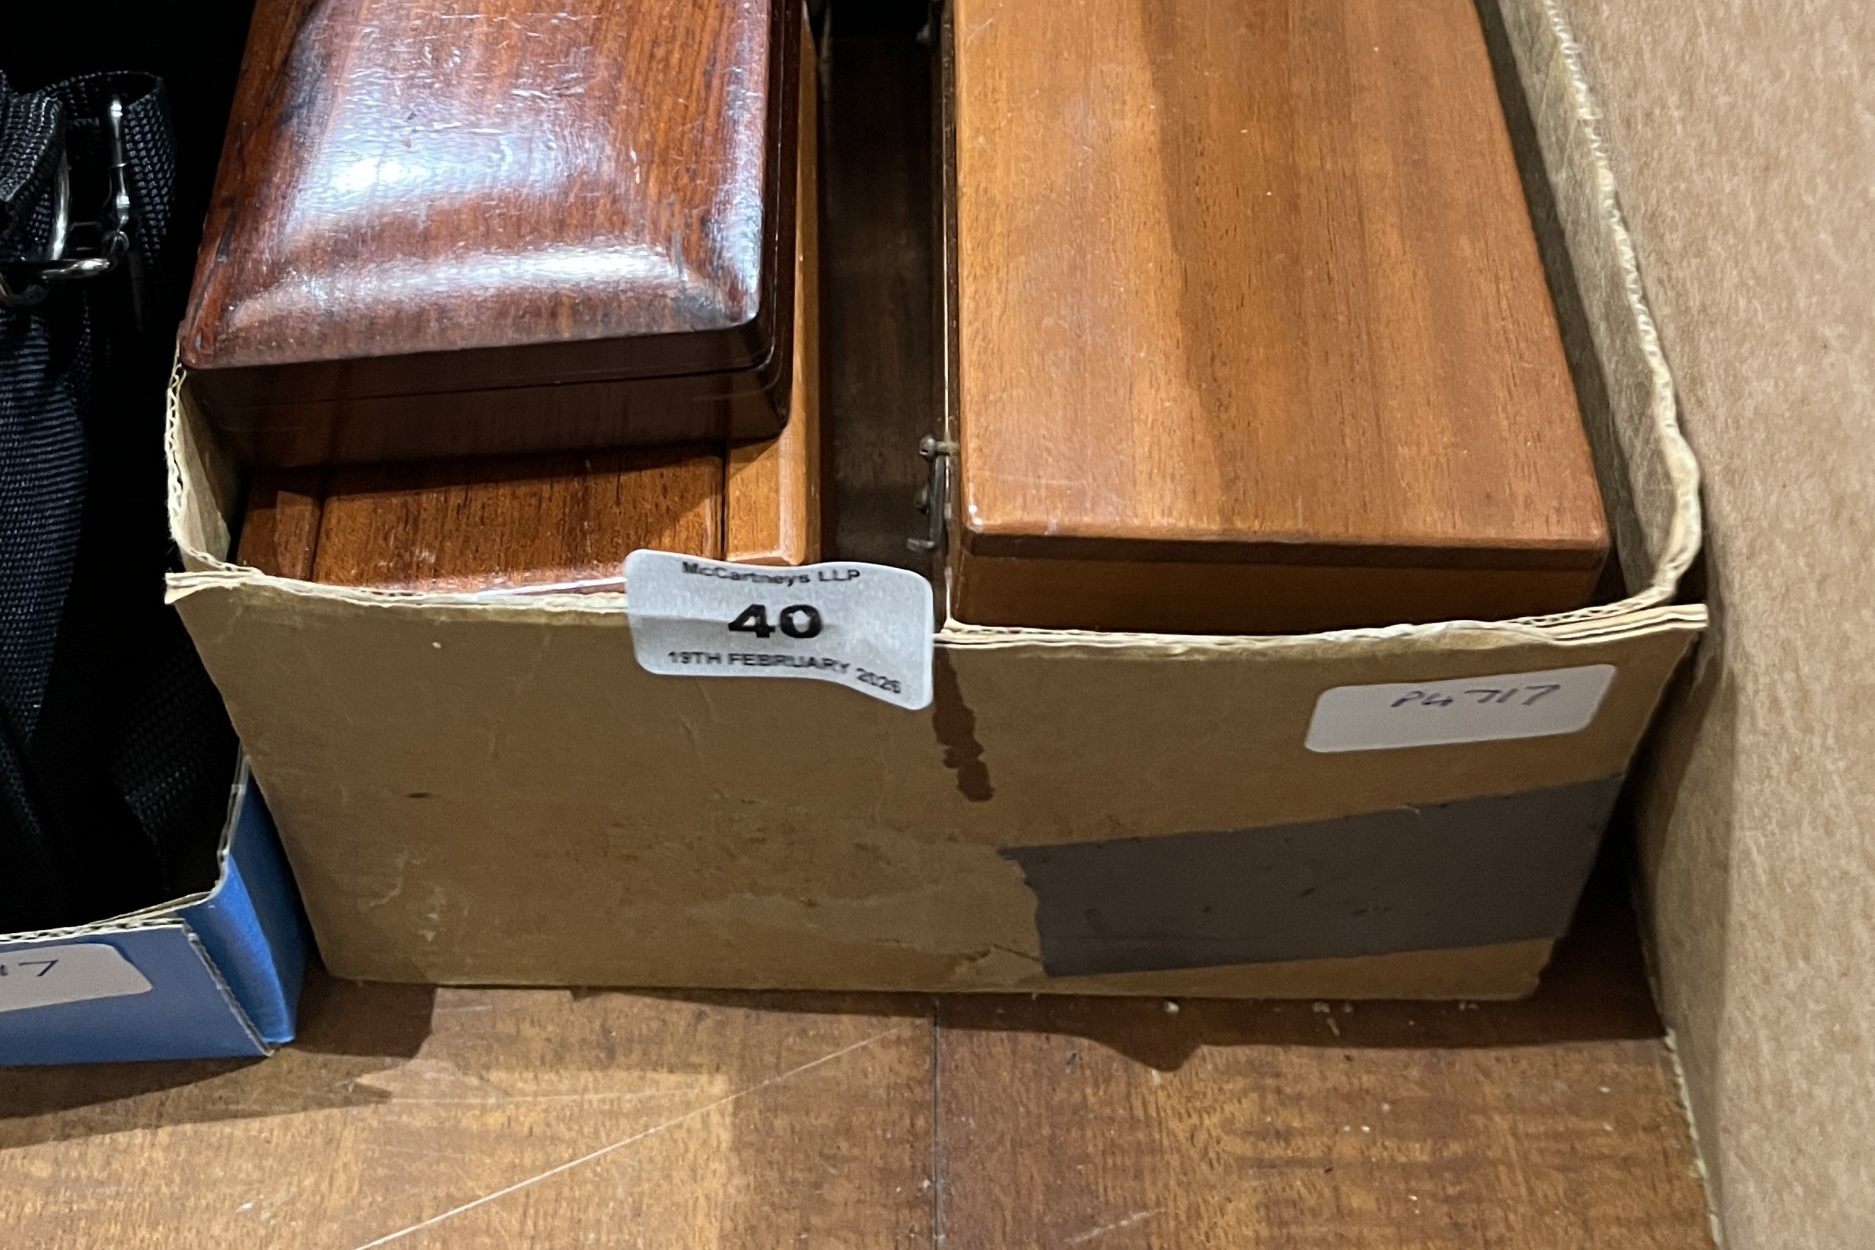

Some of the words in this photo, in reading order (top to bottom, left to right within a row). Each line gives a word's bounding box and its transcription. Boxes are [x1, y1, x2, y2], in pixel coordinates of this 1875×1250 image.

[682, 561, 810, 586] McCartneys
[818, 569, 861, 582] LLP
[728, 604, 823, 638] 40
[728, 653, 851, 674] FEBRUARY
